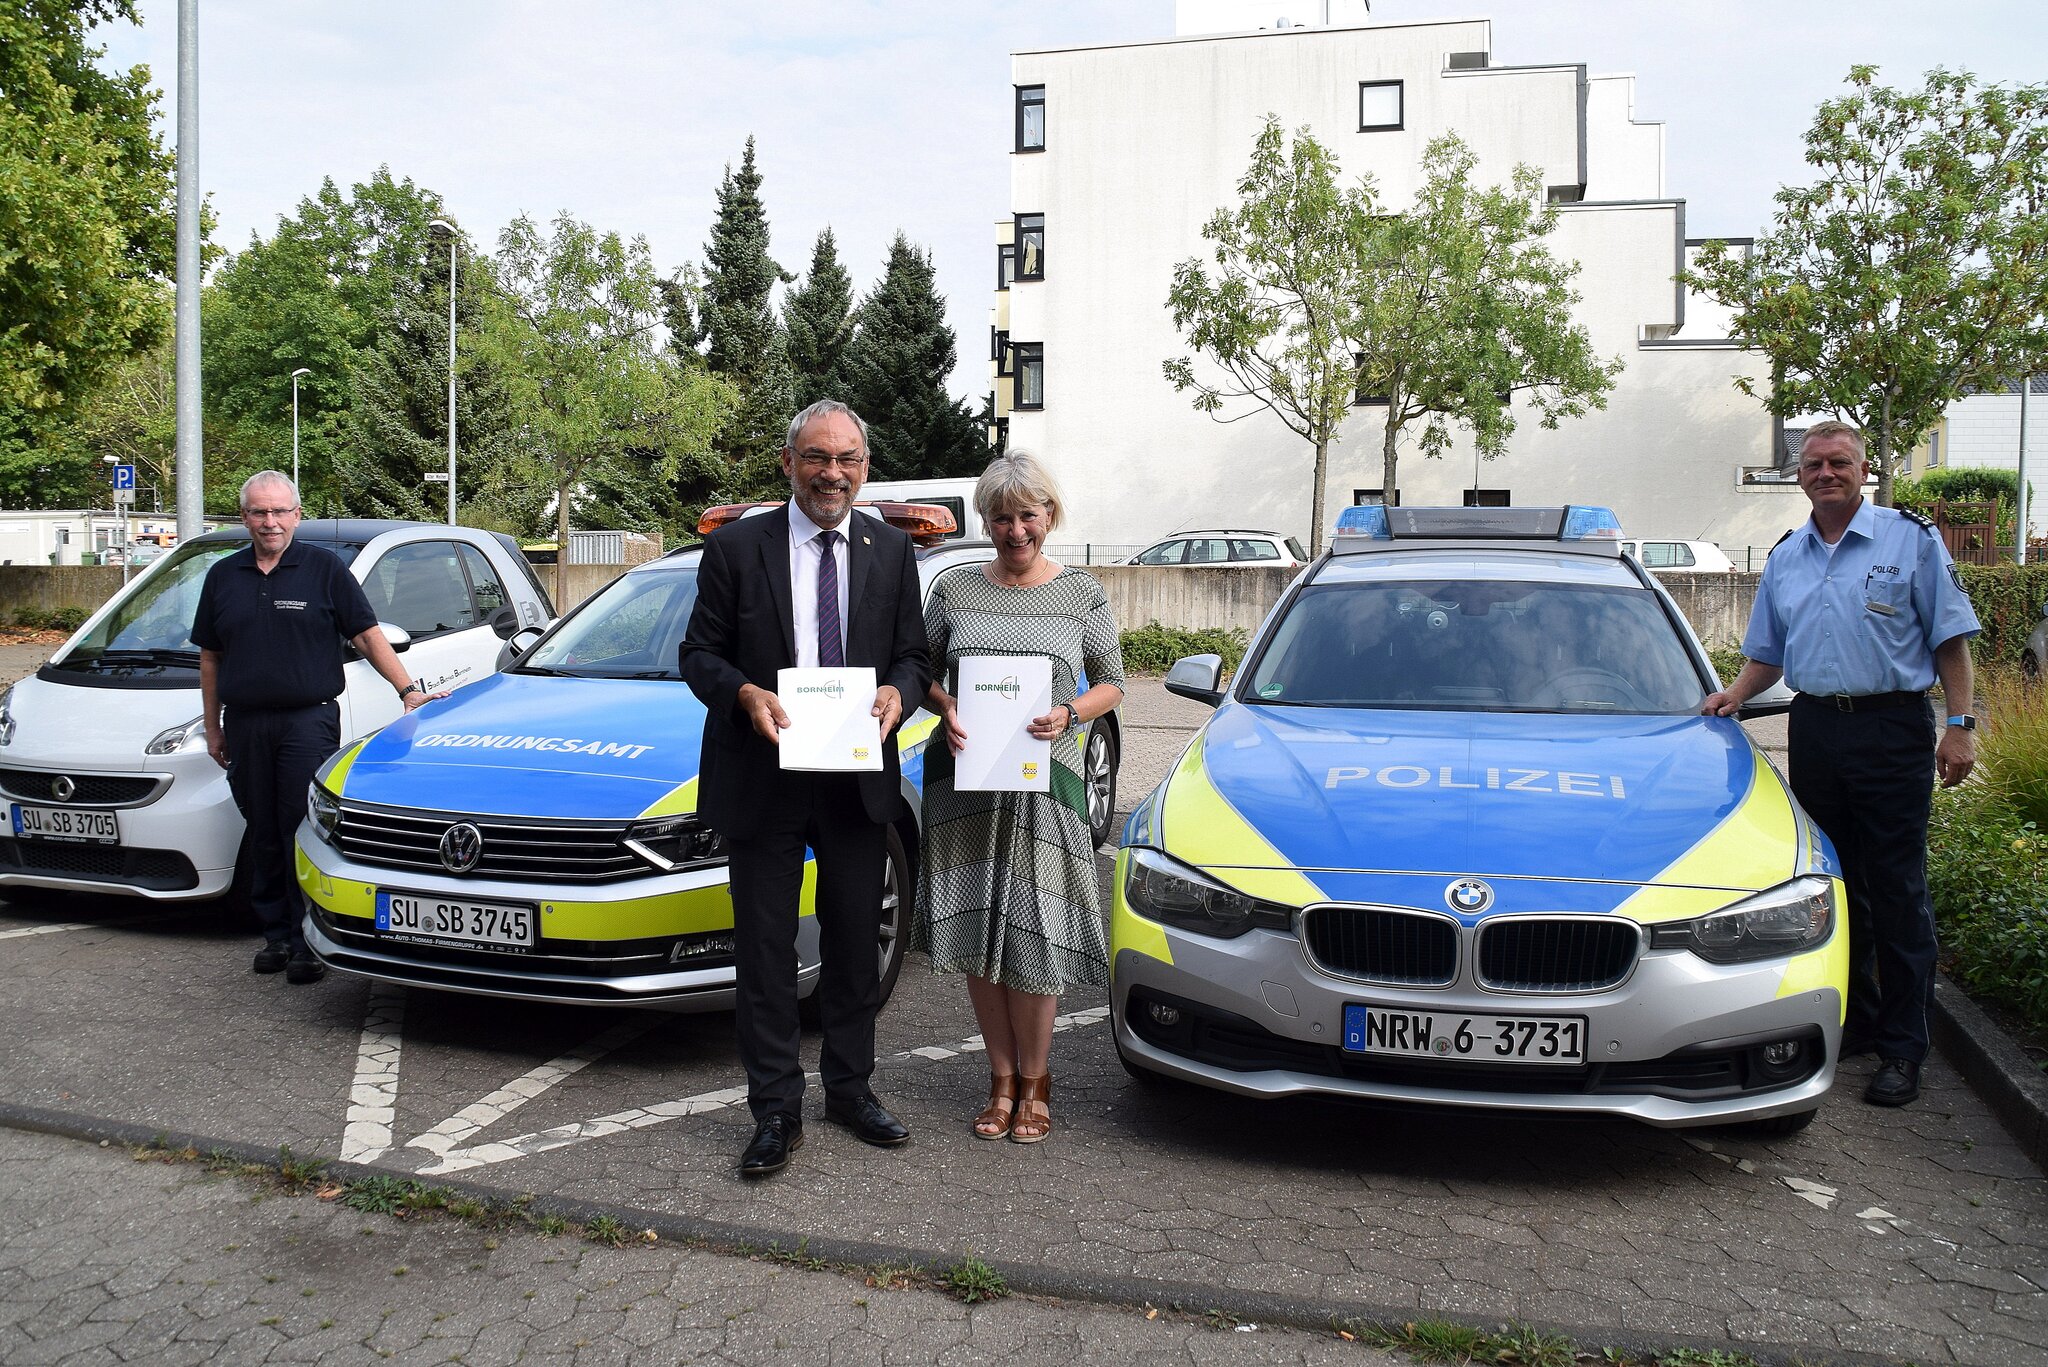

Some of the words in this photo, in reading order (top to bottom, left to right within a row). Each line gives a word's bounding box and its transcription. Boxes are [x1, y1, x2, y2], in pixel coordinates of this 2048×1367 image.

[117, 468, 130, 488] P
[1872, 565, 1900, 575] POLIZEI
[415, 734, 656, 759] ORDNUNGSAMT
[1325, 765, 1626, 799] POLIZEI
[22, 809, 42, 831] SU
[52, 812, 72, 833] SB
[75, 813, 114, 835] 3705
[380, 914, 386, 924] D
[391, 898, 418, 928] SU
[436, 904, 464, 933] SB
[470, 907, 527, 940] 3745
[1350, 1032, 1359, 1043] D
[1366, 1011, 1433, 1051] NRW
[1454, 1018, 1581, 1058] 6-3731
